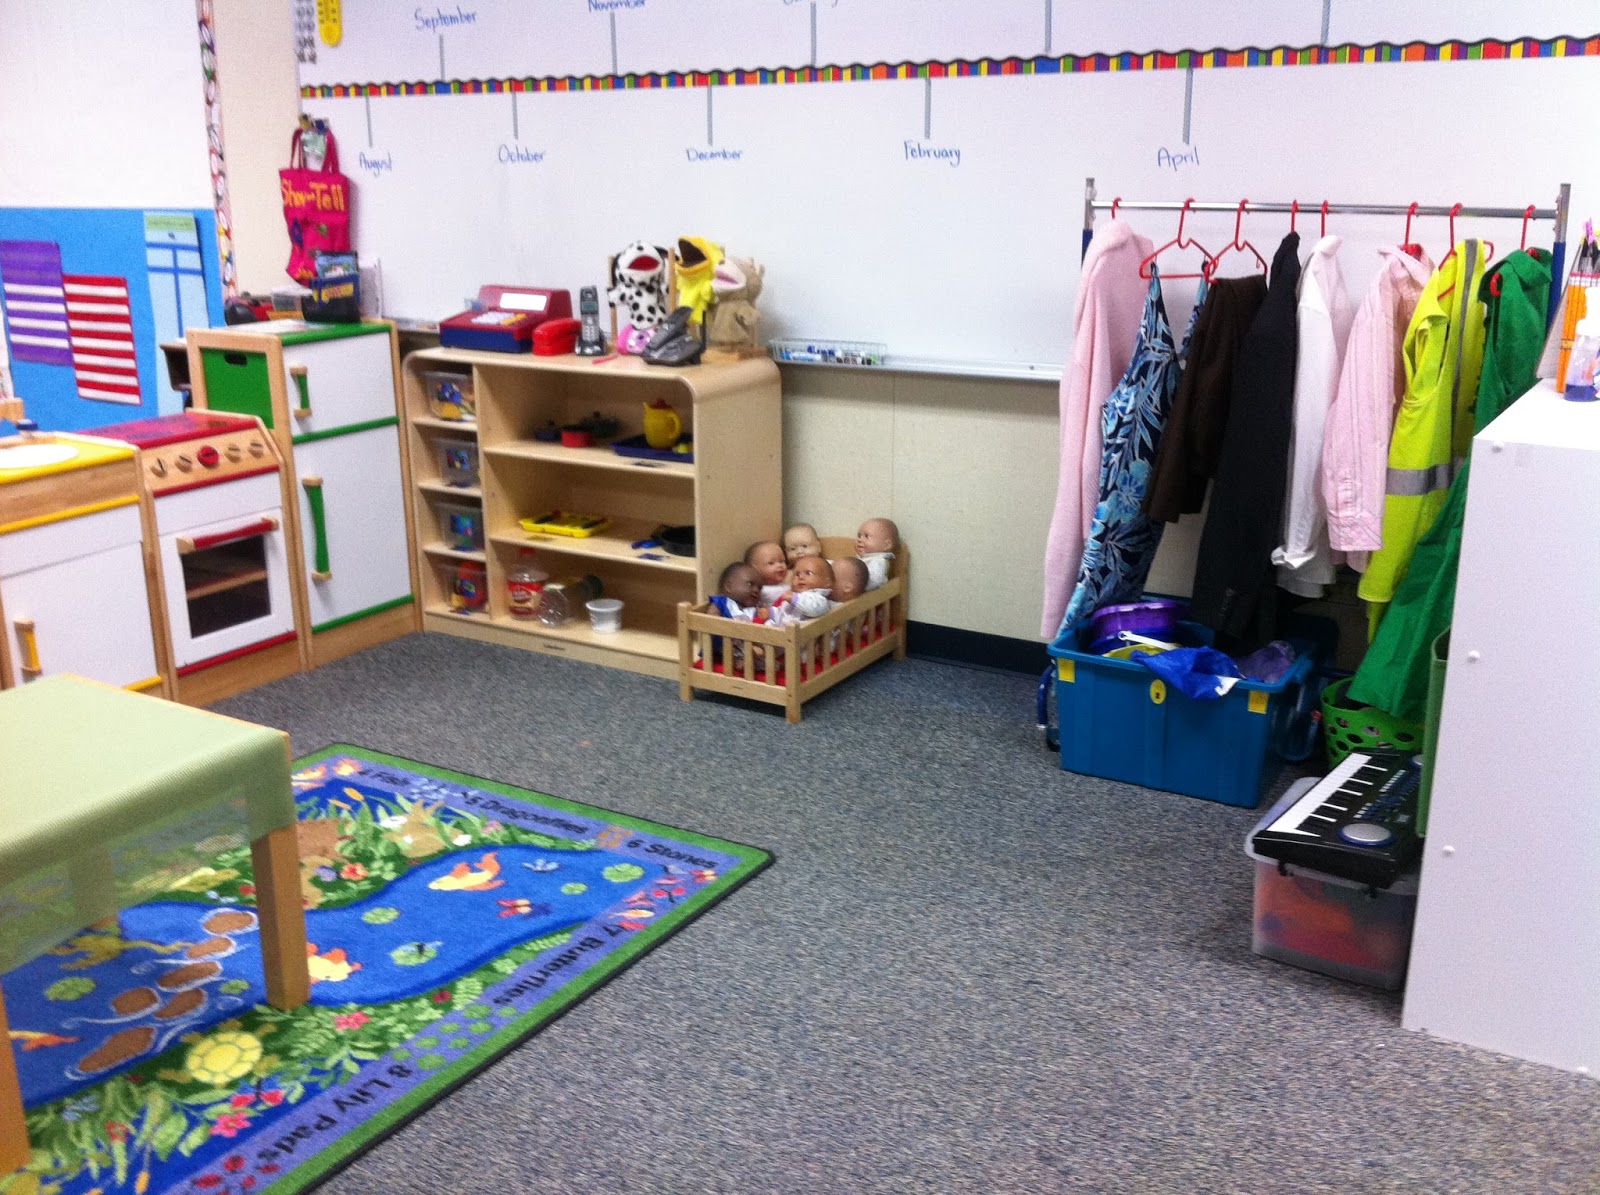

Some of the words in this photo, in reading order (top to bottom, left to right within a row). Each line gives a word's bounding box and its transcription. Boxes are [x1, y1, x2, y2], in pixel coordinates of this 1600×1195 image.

[414, 5, 477, 33] September
[359, 151, 392, 178] August
[498, 144, 545, 163] October
[686, 148, 742, 162] December
[904, 141, 961, 167] February
[1157, 147, 1200, 170] April
[480, 799, 589, 834] Dragonflies
[627, 839, 645, 849] 6
[644, 843, 719, 869] Stones
[493, 936, 605, 1005] Butterflies
[387, 1064, 414, 1079] 8
[332, 1078, 392, 1113] Lily
[256, 1113, 338, 1161] Pads
